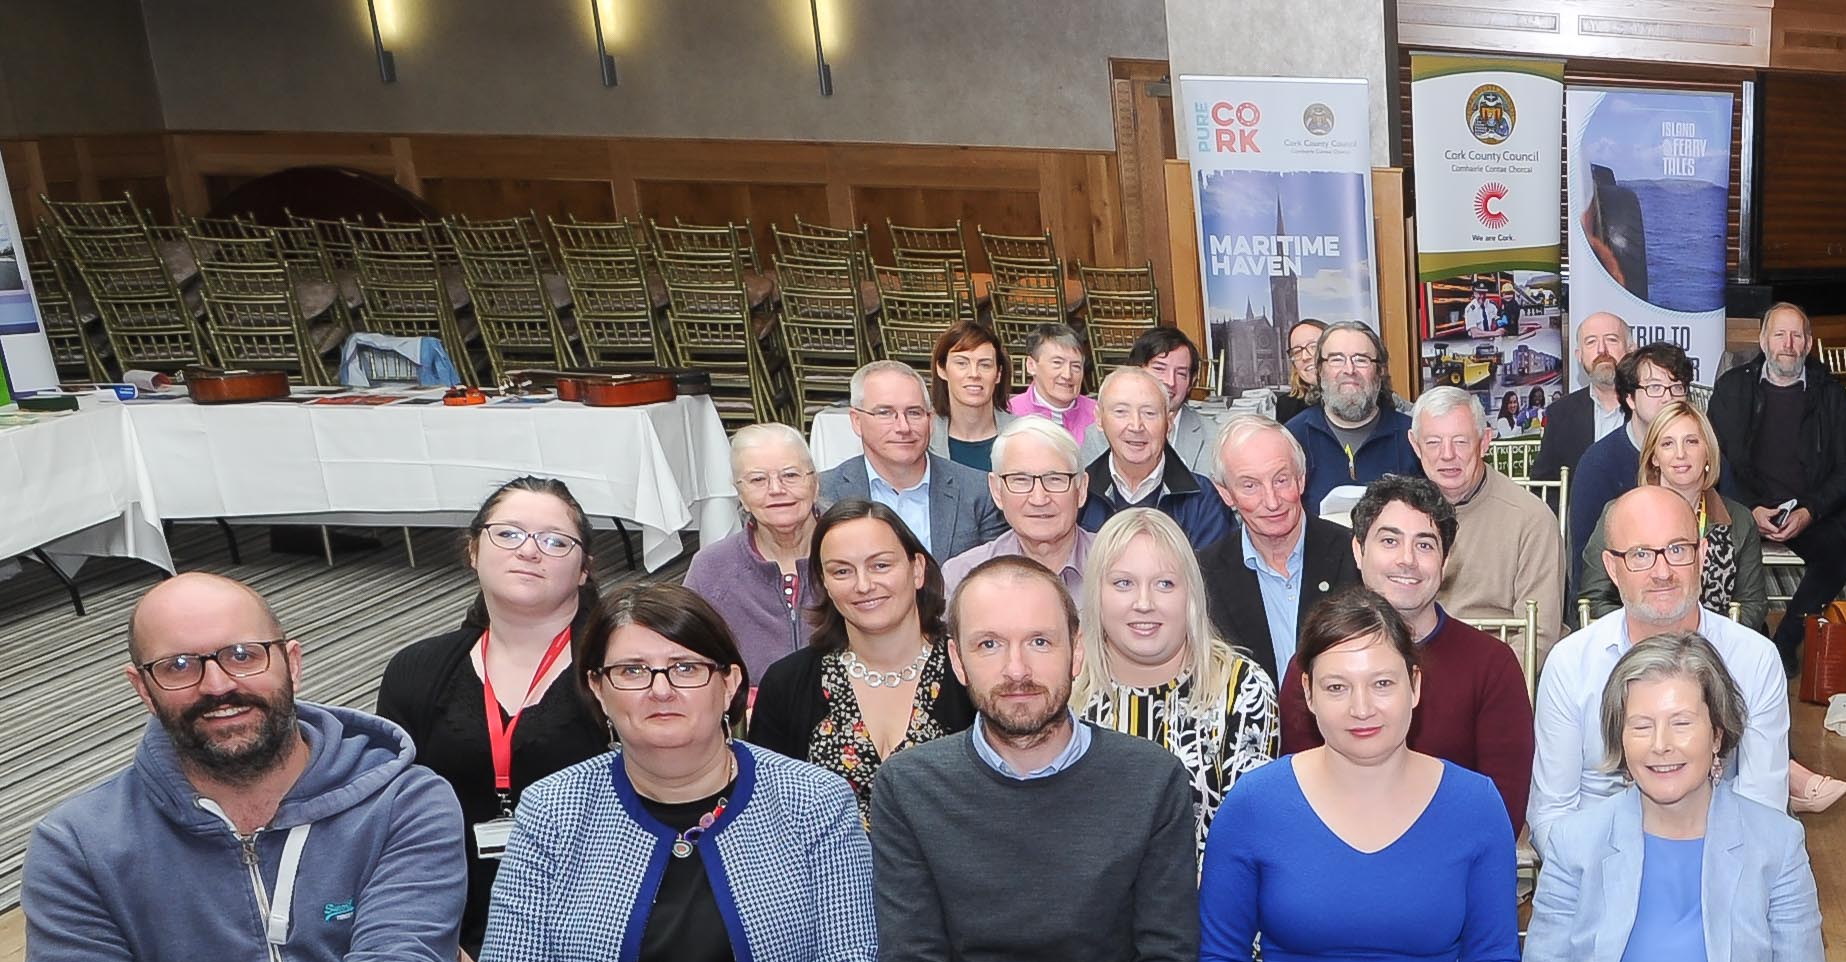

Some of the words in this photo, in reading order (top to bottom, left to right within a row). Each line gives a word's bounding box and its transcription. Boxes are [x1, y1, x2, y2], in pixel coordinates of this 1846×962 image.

[1211, 101, 1260, 127] CO
[1194, 102, 1211, 152] PURE
[1662, 121, 1695, 138] ISLAND
[1215, 128, 1261, 153] RK
[1444, 149, 1466, 160] Cork
[1468, 150, 1501, 163] County
[1502, 151, 1540, 162] Council
[1663, 157, 1695, 176] TALES
[1209, 234, 1340, 257] MARITIME
[1211, 255, 1302, 276] HAVEN
[1670, 326, 1691, 352] TO
